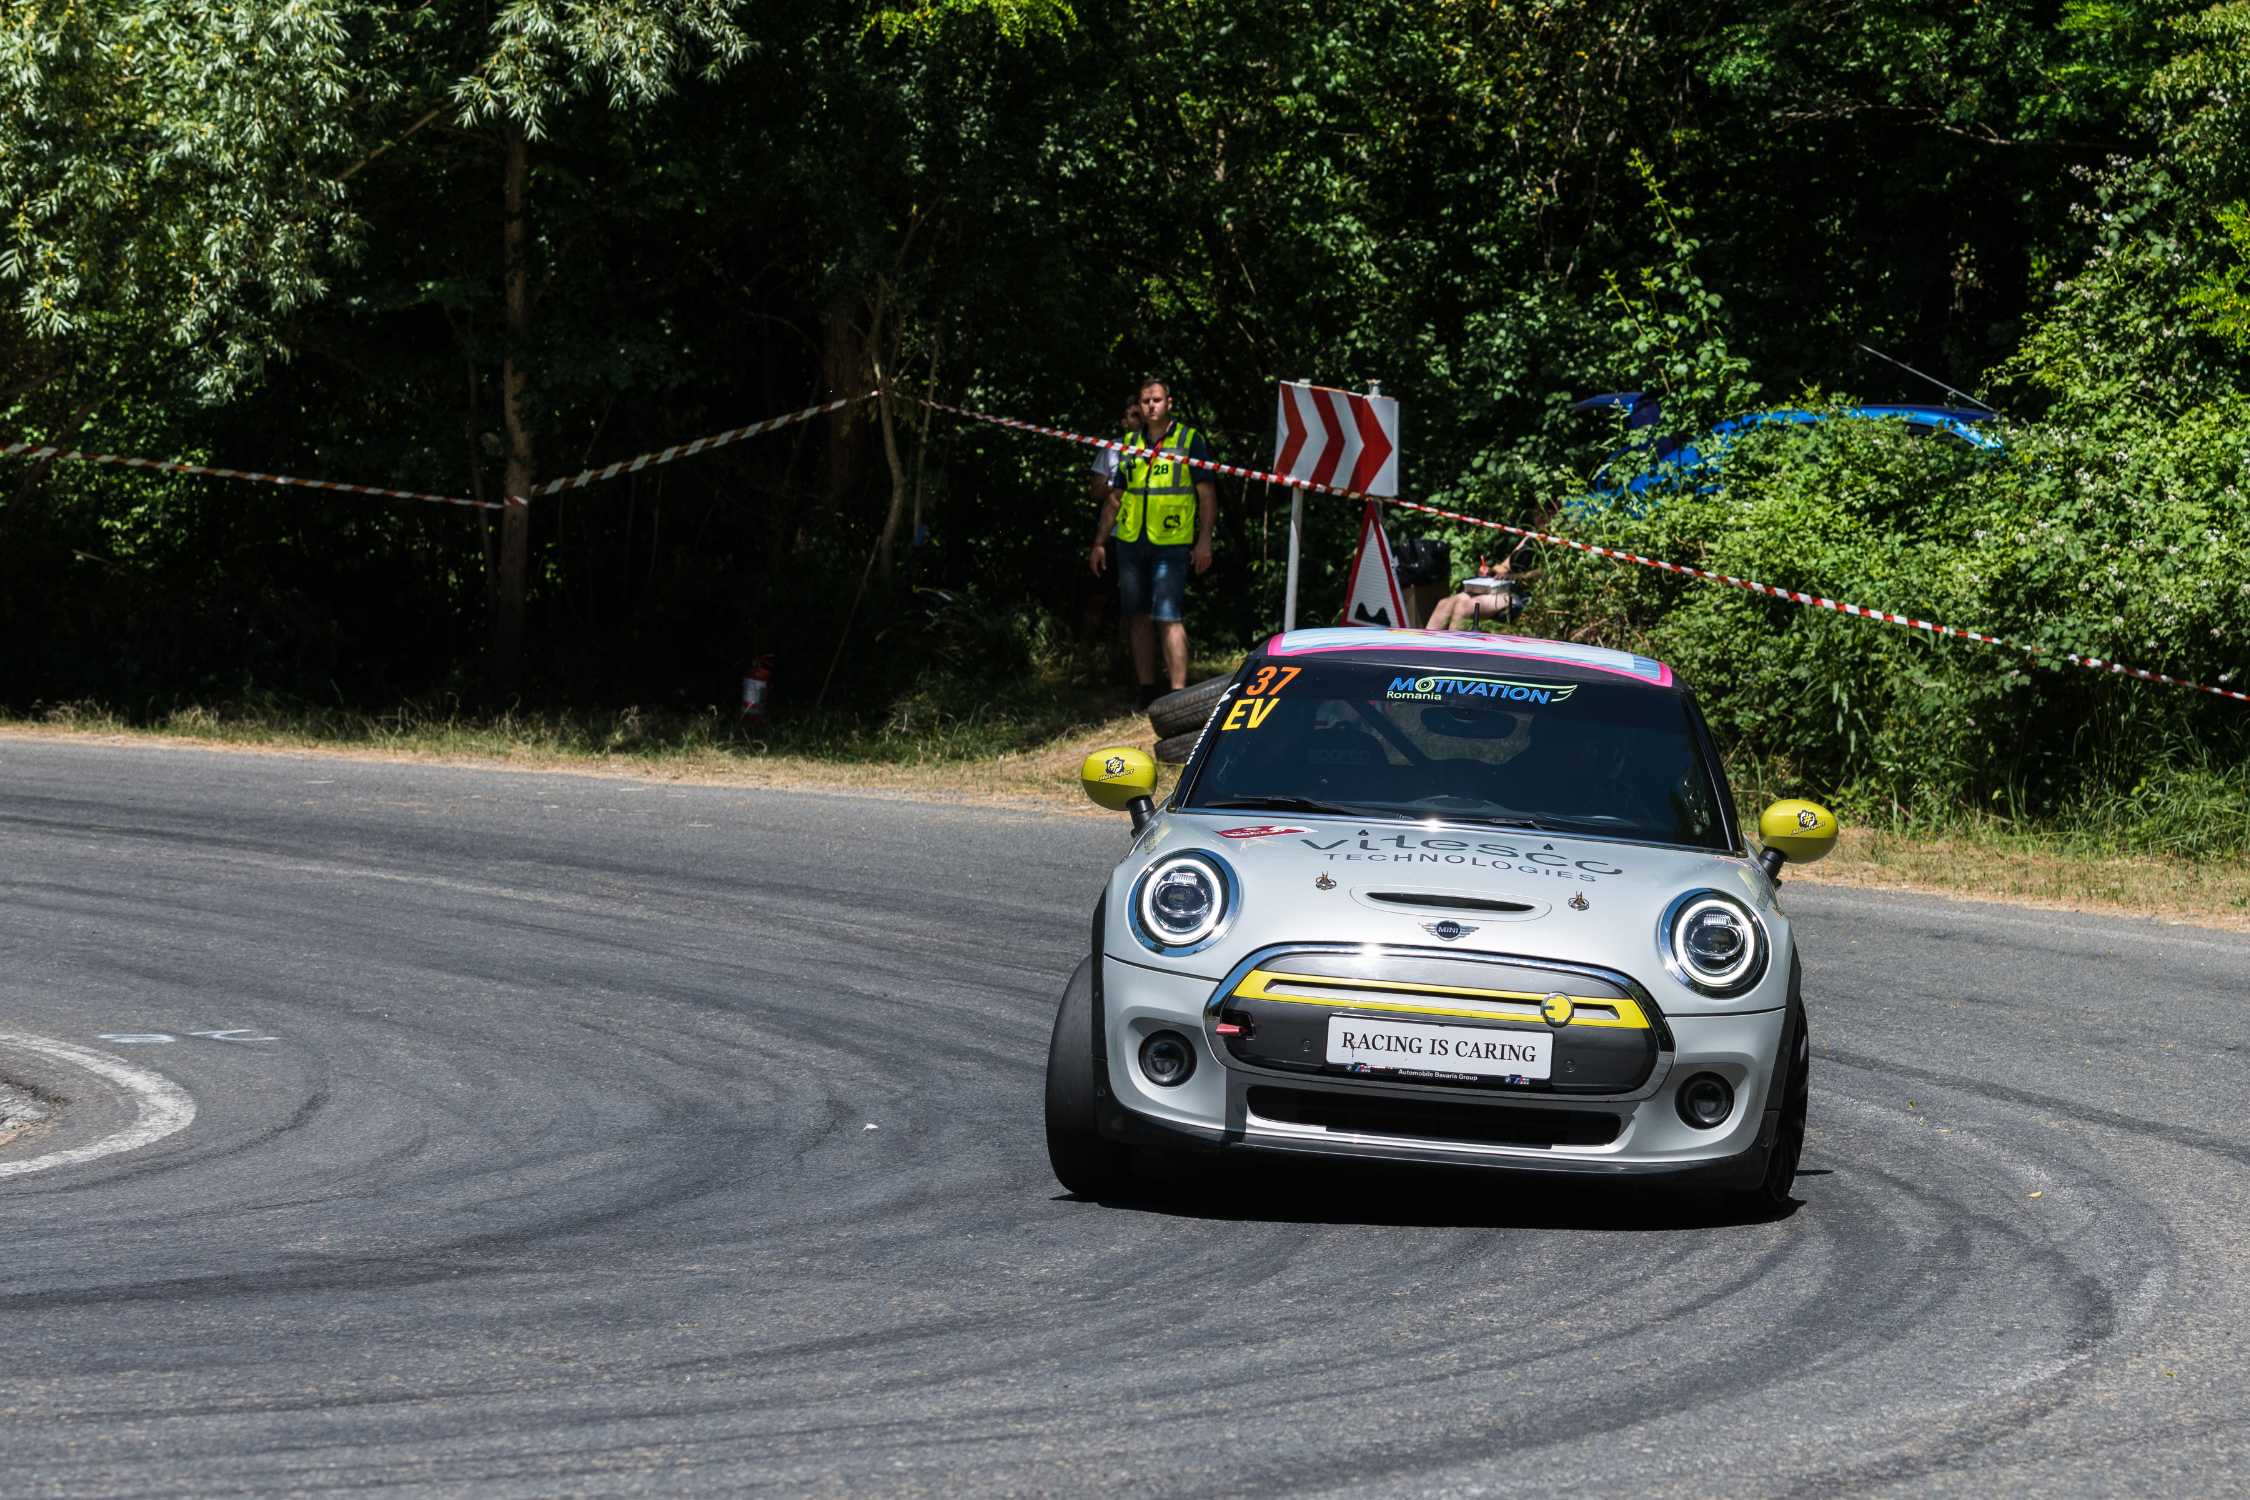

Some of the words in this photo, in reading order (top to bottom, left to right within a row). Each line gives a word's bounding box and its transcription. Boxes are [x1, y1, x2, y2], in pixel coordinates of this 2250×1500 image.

[1246, 666, 1302, 696] 37
[1386, 690, 1442, 701] Romania
[1387, 676, 1551, 705] MOTIVATION
[1221, 698, 1280, 731] EV
[1323, 854, 1597, 883] TECHNOLOGIES
[1437, 926, 1460, 934] MINI
[1341, 1031, 1423, 1054] RACING
[1428, 1038, 1449, 1056] IS
[1455, 1040, 1537, 1063] CARING
[1398, 1068, 1434, 1078] Automobile
[1434, 1071, 1458, 1080] Bavaria
[1459, 1073, 1478, 1082] Group
